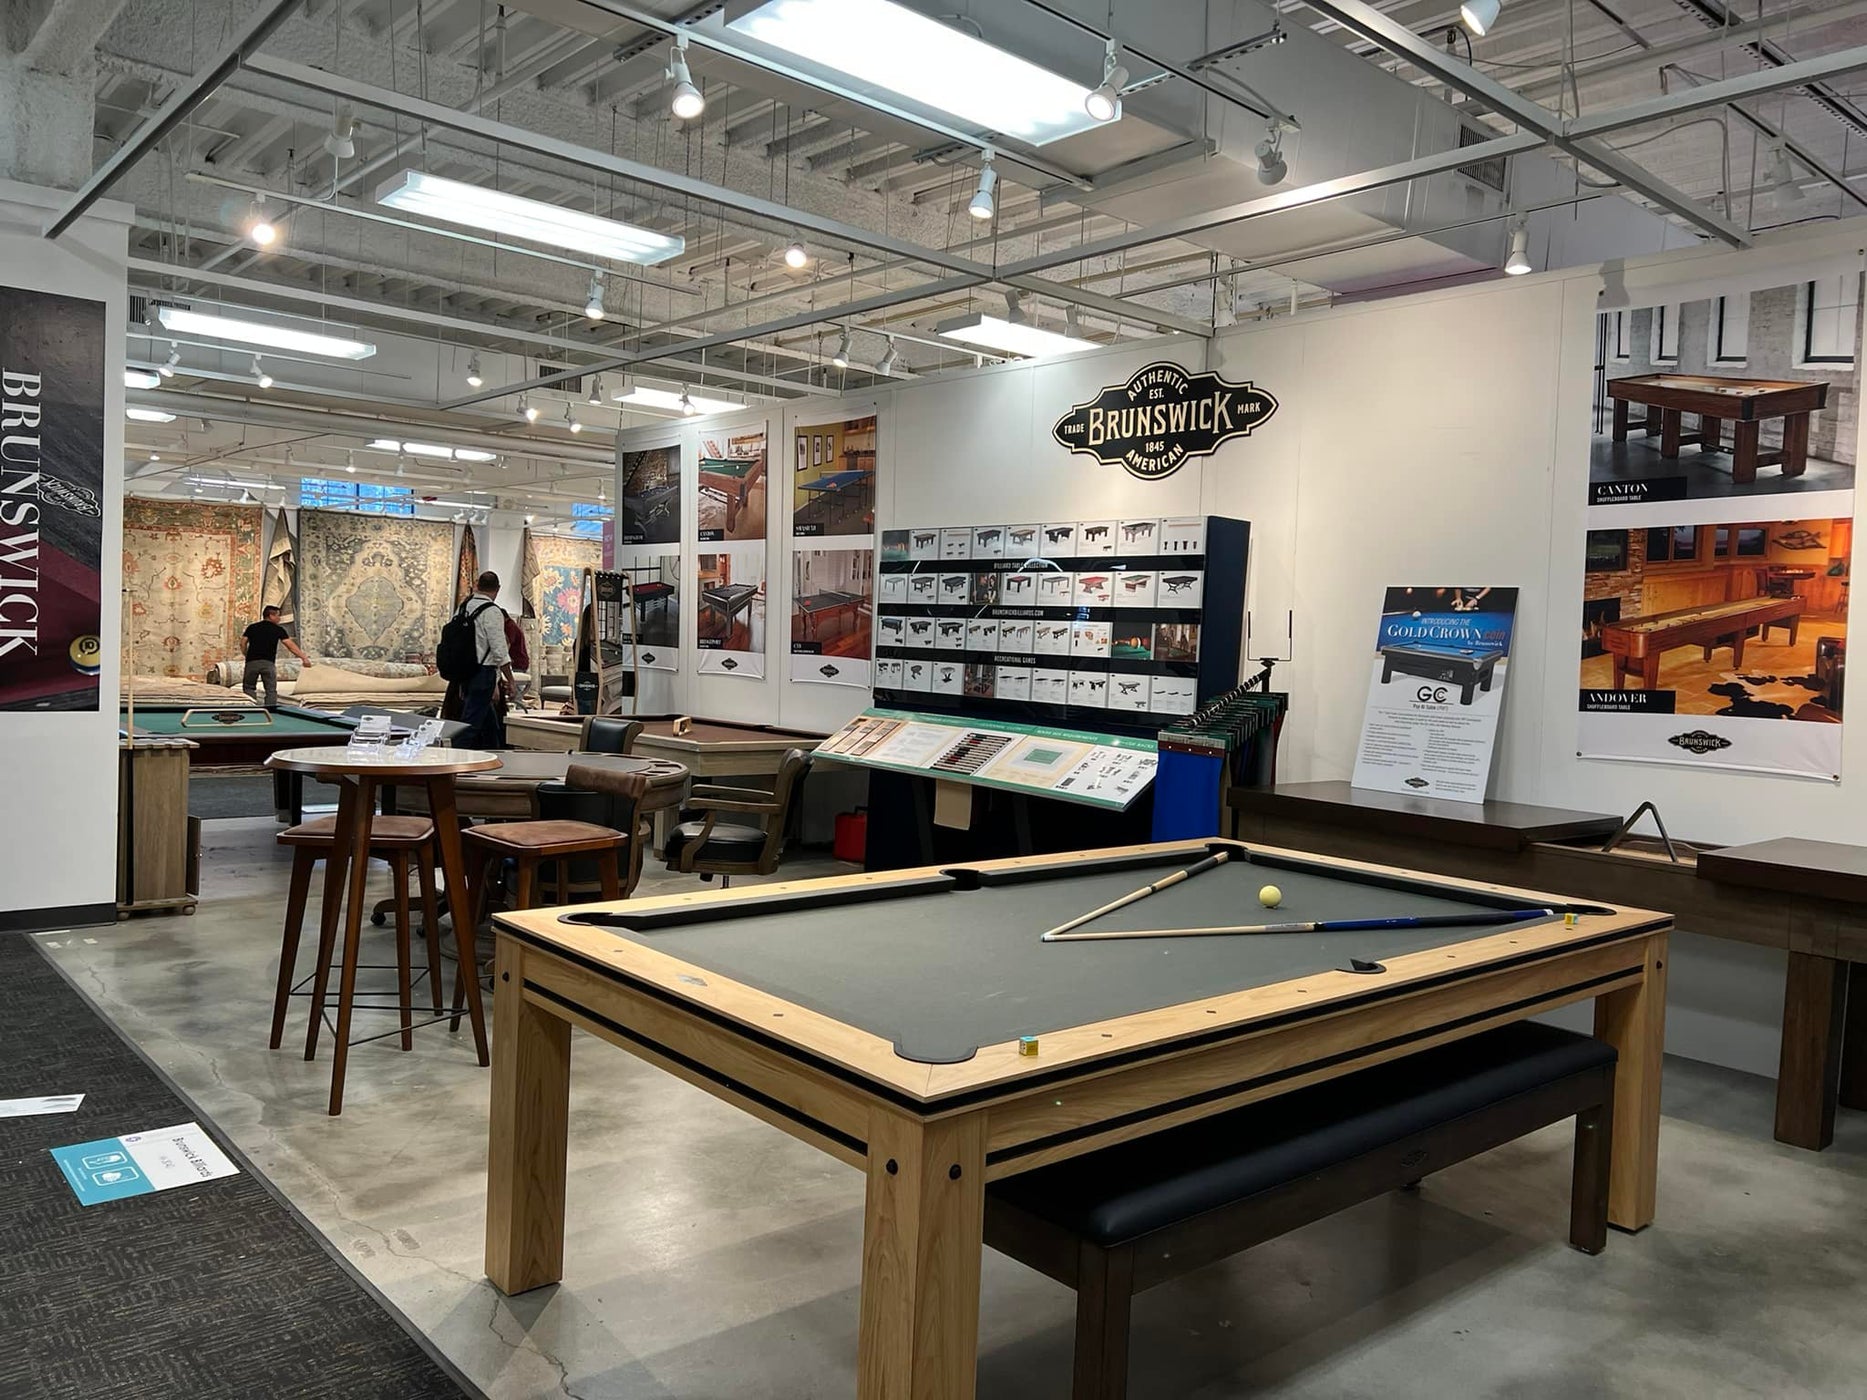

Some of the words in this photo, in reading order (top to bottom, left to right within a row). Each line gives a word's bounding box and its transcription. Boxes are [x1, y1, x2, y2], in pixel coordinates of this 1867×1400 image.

[1127, 369, 1189, 401] AUTHENTIC
[1149, 388, 1164, 399] EST.
[1237, 401, 1261, 414] MARK
[1088, 391, 1234, 446] BRUNSWICK
[1064, 423, 1085, 434] TRADE
[1145, 441, 1164, 452] 1845
[1126, 443, 1184, 471] AMERICAN
[1597, 483, 1647, 495] CANTON
[0, 367, 41, 656] BRUNSWICK
[1590, 693, 1646, 703] ANDOVER
[1679, 736, 1721, 747] BRUNSWICK
